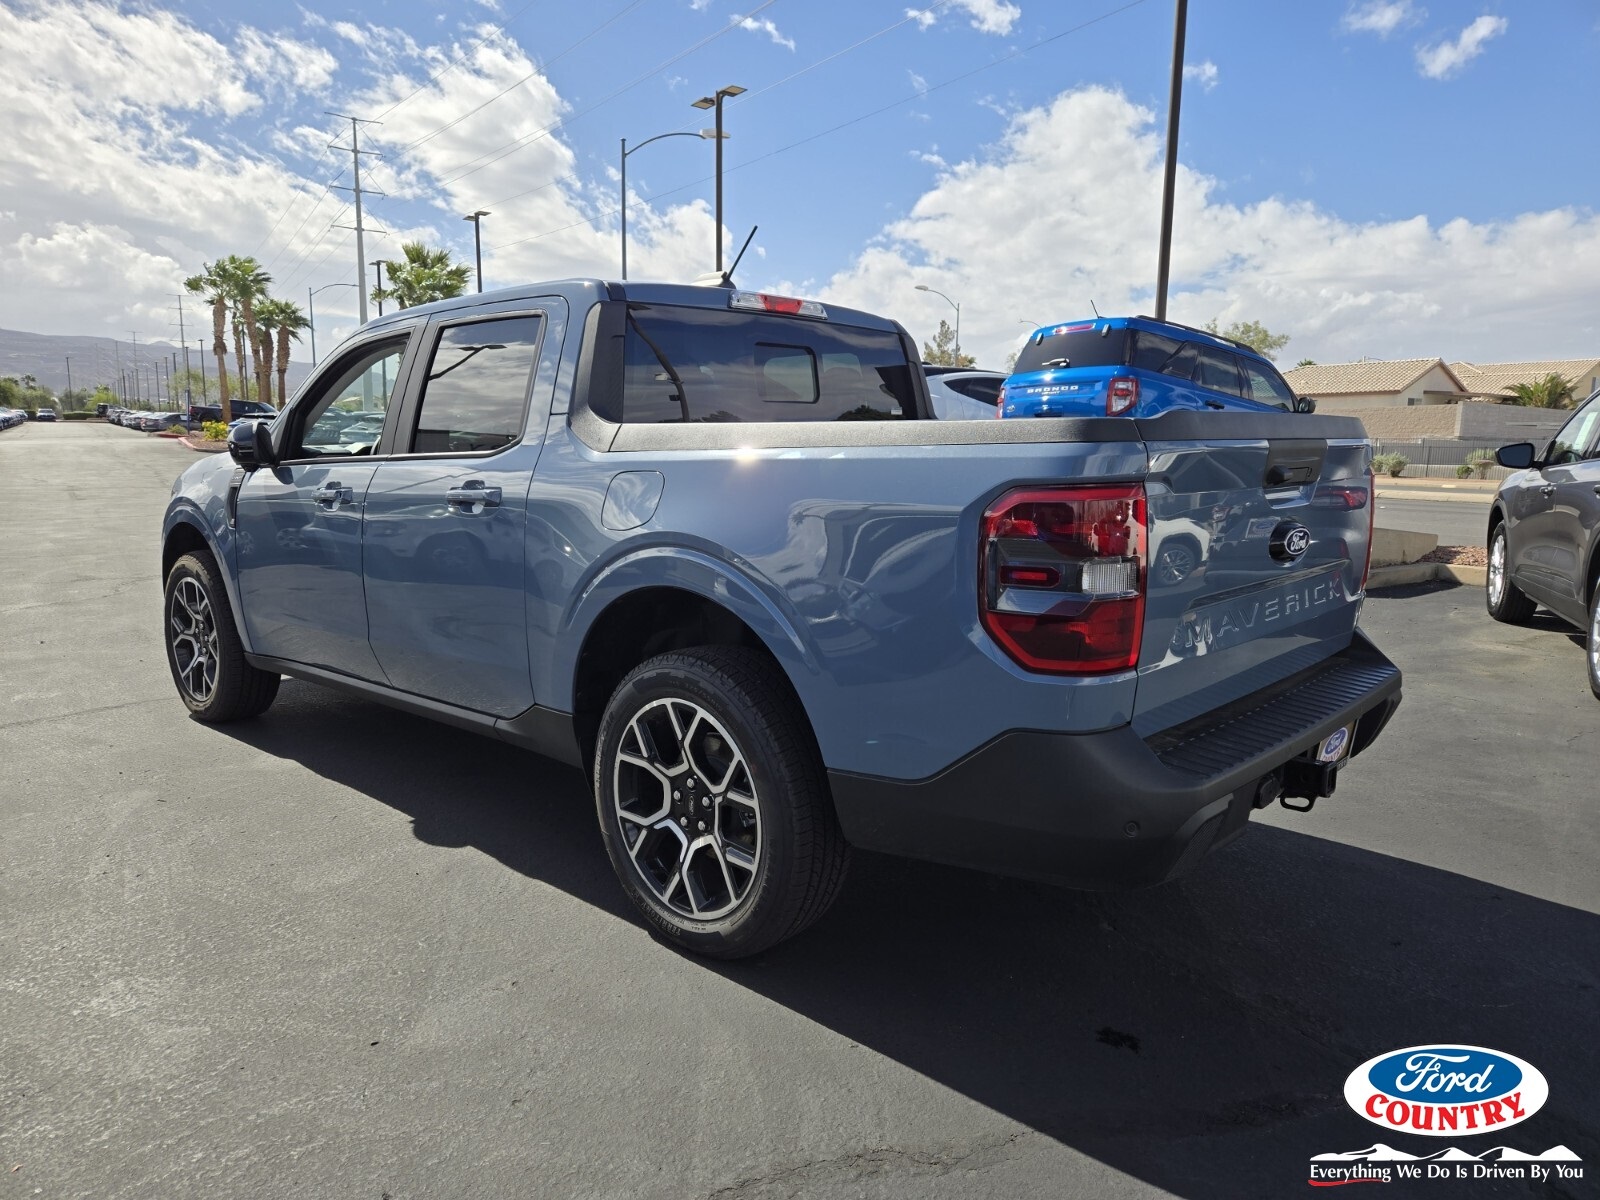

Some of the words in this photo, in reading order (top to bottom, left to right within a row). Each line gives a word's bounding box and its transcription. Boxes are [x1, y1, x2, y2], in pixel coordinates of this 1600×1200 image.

[1026, 385, 1079, 394] BRONCO
[1290, 532, 1307, 551] Ford
[1184, 577, 1341, 649] MAVERICK
